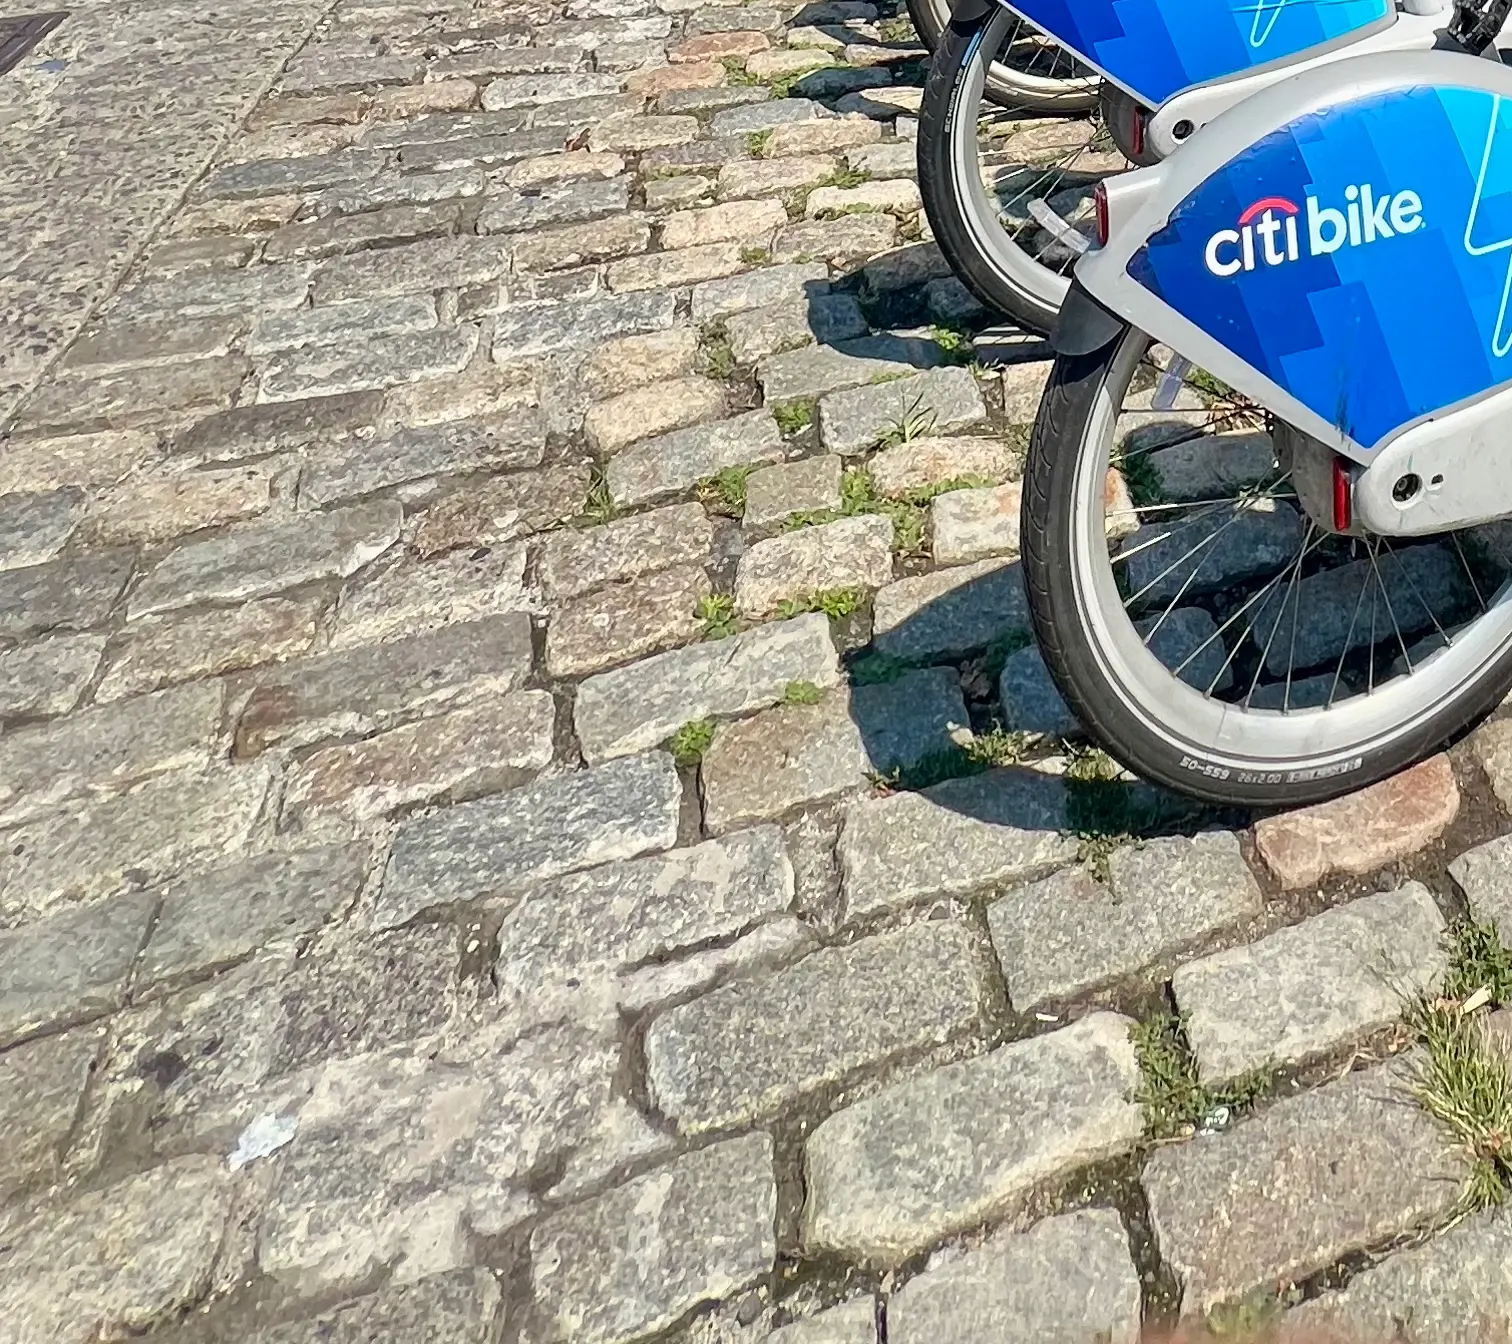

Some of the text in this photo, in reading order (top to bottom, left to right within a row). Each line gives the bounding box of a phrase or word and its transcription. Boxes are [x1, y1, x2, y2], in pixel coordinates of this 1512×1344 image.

[1204, 183, 1425, 277] citi bike
[1179, 755, 1231, 781] 50-559
